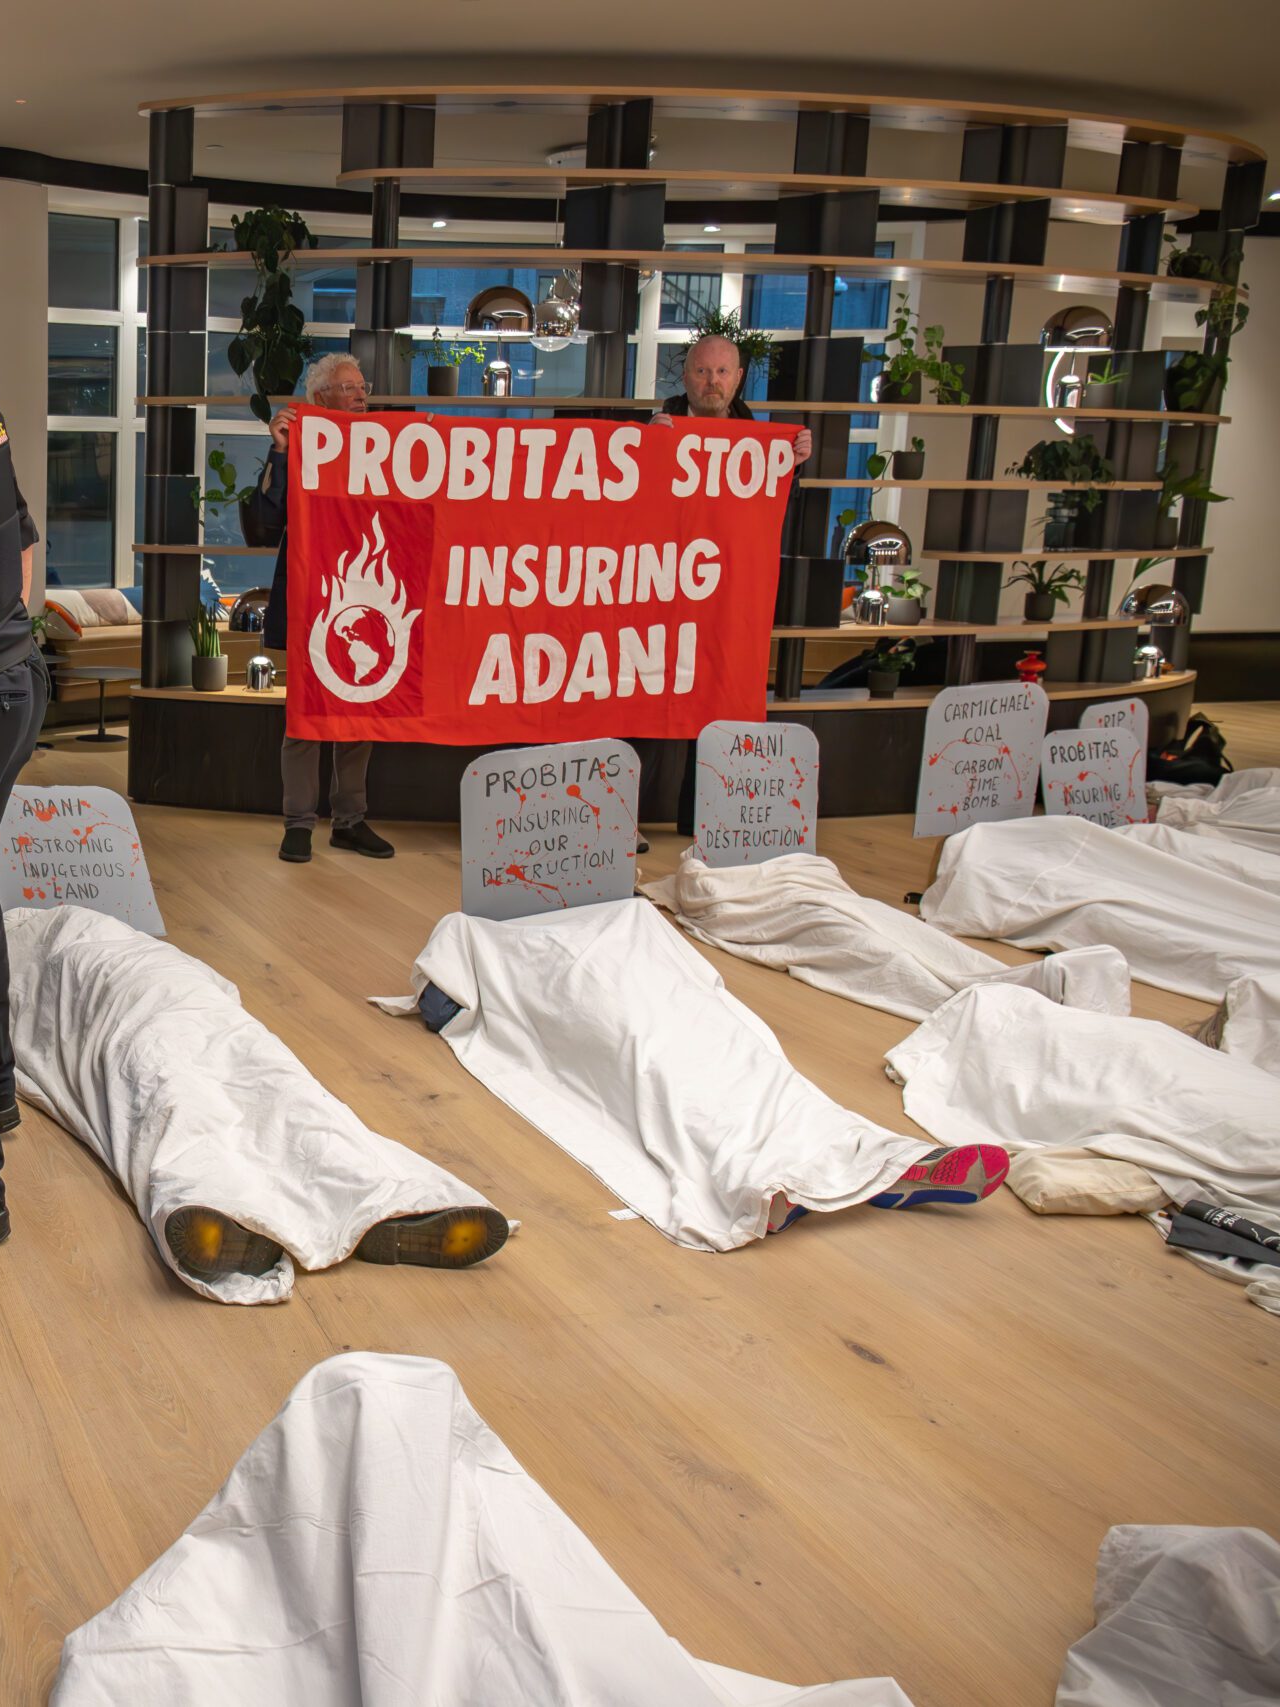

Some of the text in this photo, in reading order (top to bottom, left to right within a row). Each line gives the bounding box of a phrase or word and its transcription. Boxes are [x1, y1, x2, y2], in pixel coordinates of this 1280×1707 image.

[301, 415, 794, 501] PROBITAS STOP
[445, 538, 721, 608] INSURING
[468, 622, 697, 706] ADANI
[944, 694, 1030, 723] CARMICHAEL
[1104, 711, 1126, 728] RIP
[963, 723, 1002, 745] COAL
[730, 734, 783, 757] ADANI
[1050, 739, 1118, 764] PROBITAS
[485, 754, 621, 797] PROBITAS
[954, 756, 1004, 775] CARBON
[727, 776, 784, 797] BARRIER
[968, 776, 1000, 793] TIME
[22, 798, 82, 817] ADANI
[740, 805, 772, 823] REEF
[500, 804, 590, 836] INSURING
[11, 837, 114, 854] DESTROYING
[529, 835, 568, 855] OUR
[706, 829, 802, 849] DESTRUCTION
[22, 862, 125, 878] INDIGENOUS
[482, 848, 614, 887] DESTRUCTION
[53, 882, 99, 899] LAND
